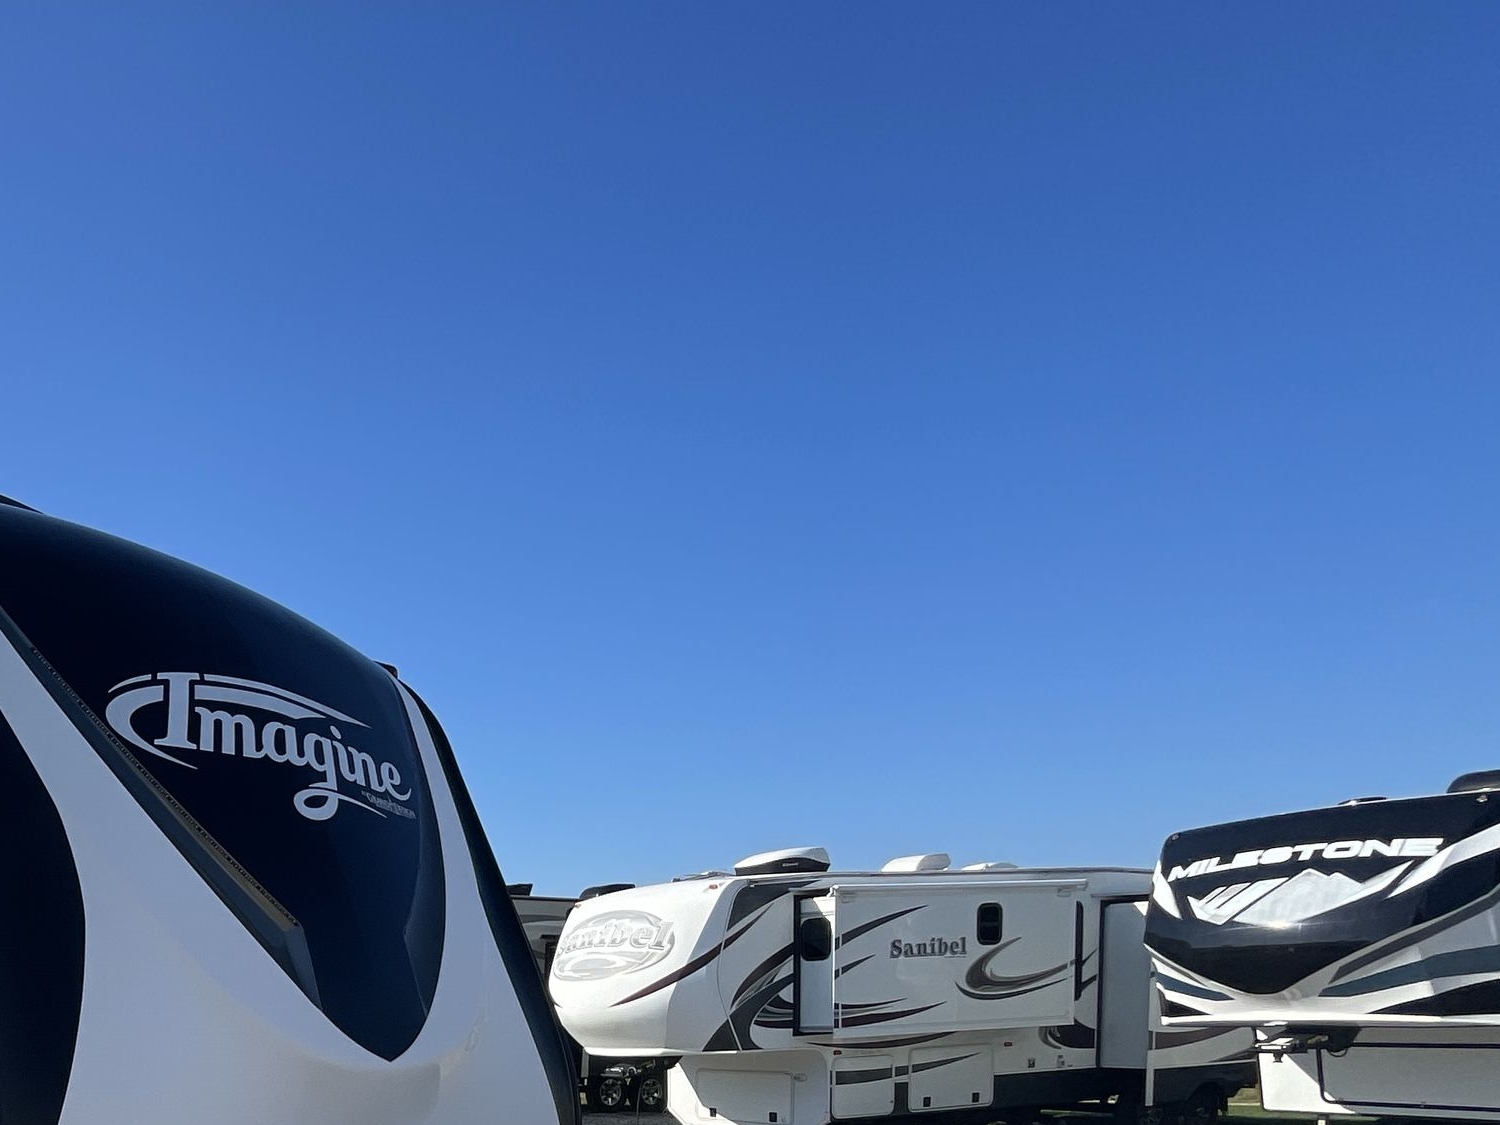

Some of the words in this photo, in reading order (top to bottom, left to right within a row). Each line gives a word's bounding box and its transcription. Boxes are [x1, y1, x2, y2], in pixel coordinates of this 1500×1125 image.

[152, 671, 412, 822] Imagine
[1167, 837, 1445, 883] MILESTONE
[889, 936, 968, 959] Sanibel
